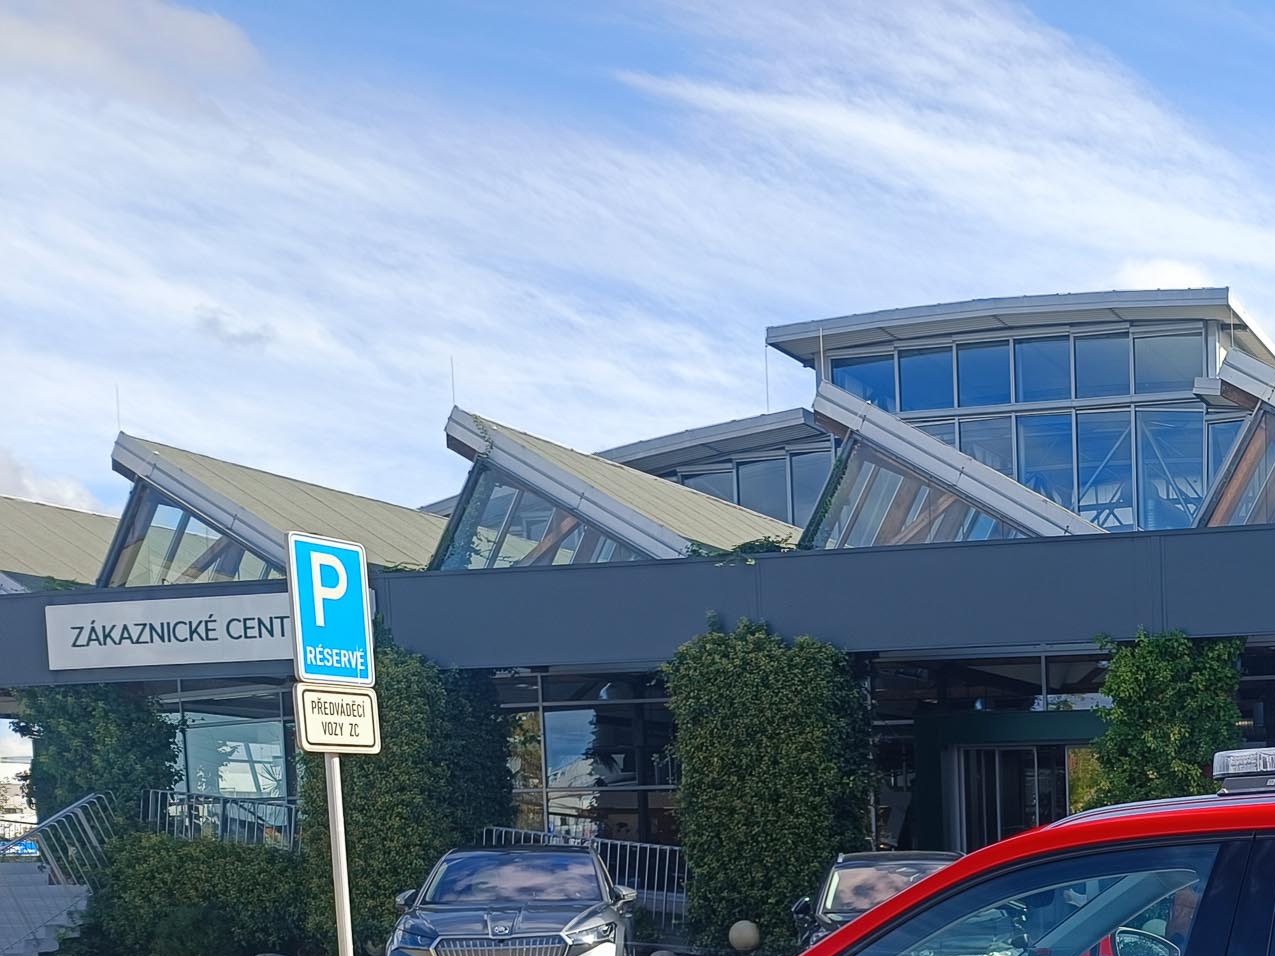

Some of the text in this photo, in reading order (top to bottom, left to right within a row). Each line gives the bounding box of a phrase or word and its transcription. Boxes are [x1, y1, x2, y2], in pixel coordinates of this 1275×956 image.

[310, 550, 348, 627] P
[70, 613, 290, 648] ZÁKAZNICKÉ CENT
[306, 643, 366, 671] RÉSERVÉ
[311, 696, 366, 718] PŘEDVÁDĚCÍ
[321, 720, 360, 738] VOZY ZC
